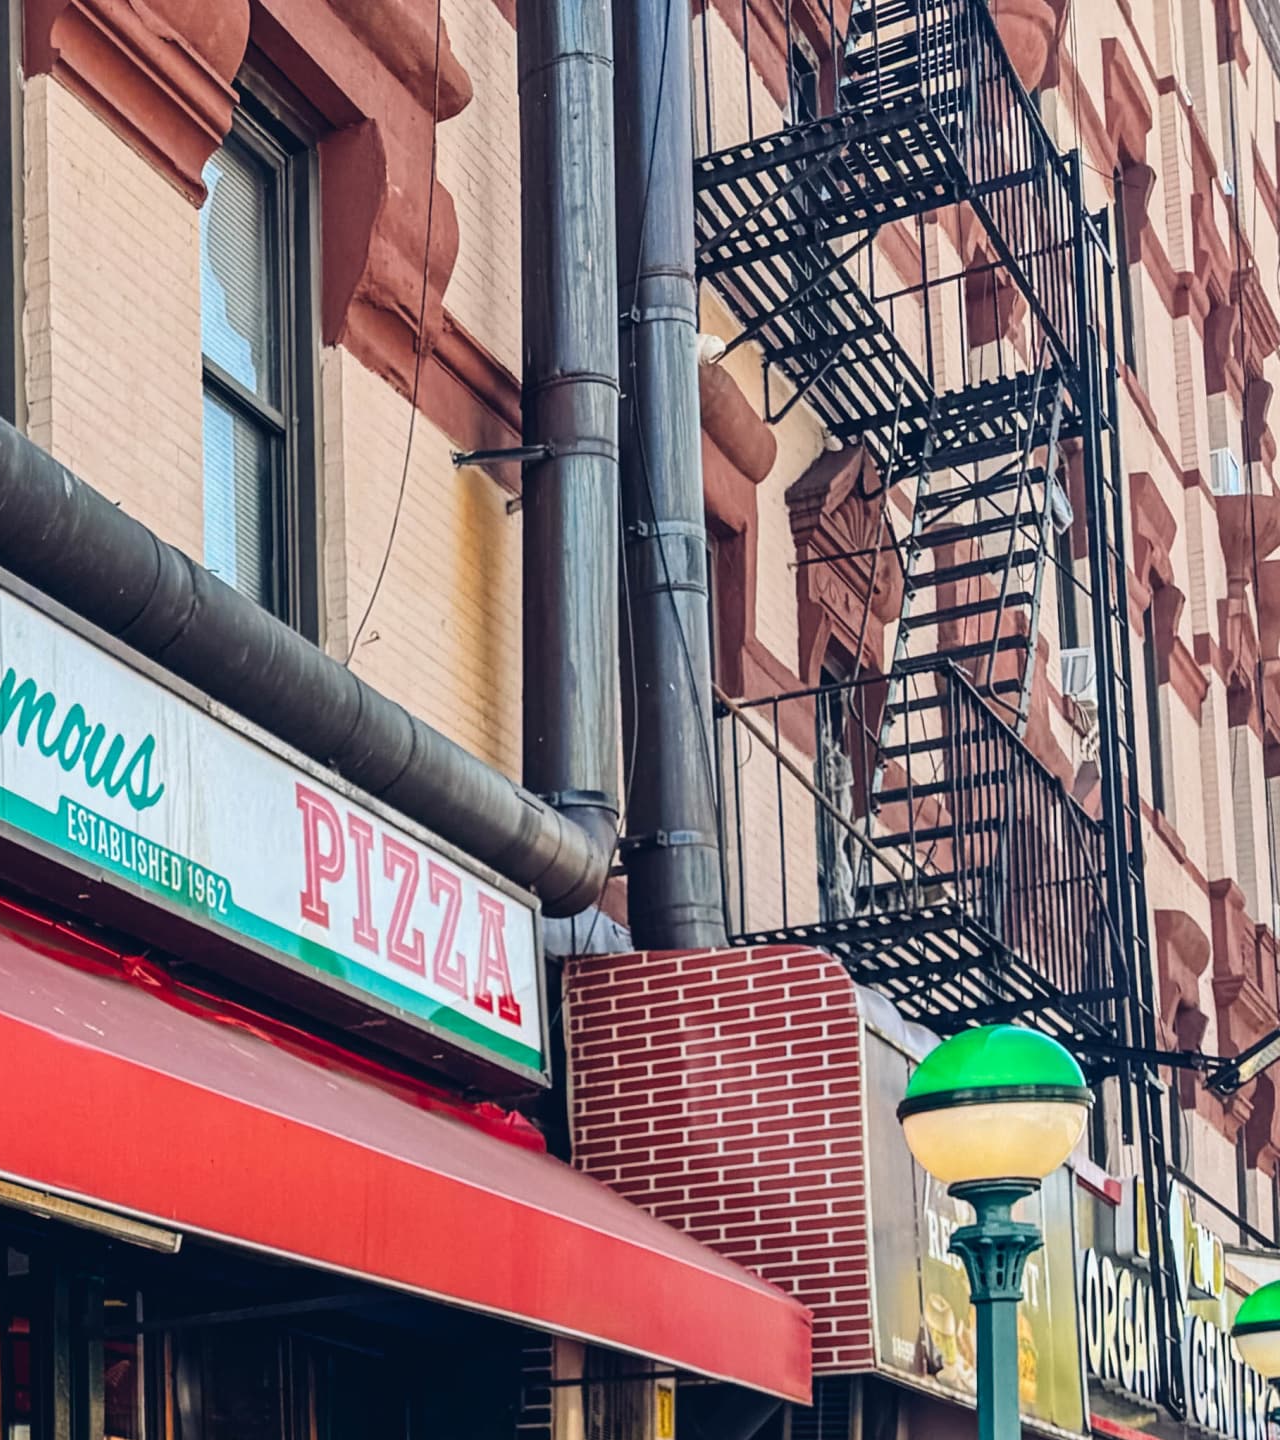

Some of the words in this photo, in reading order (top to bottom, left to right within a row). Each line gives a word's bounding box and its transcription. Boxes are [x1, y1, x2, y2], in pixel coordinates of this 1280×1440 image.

[66, 800, 184, 895] ESTABLISHED
[186, 859, 229, 915] 1962
[294, 781, 522, 1027] PIZZA
